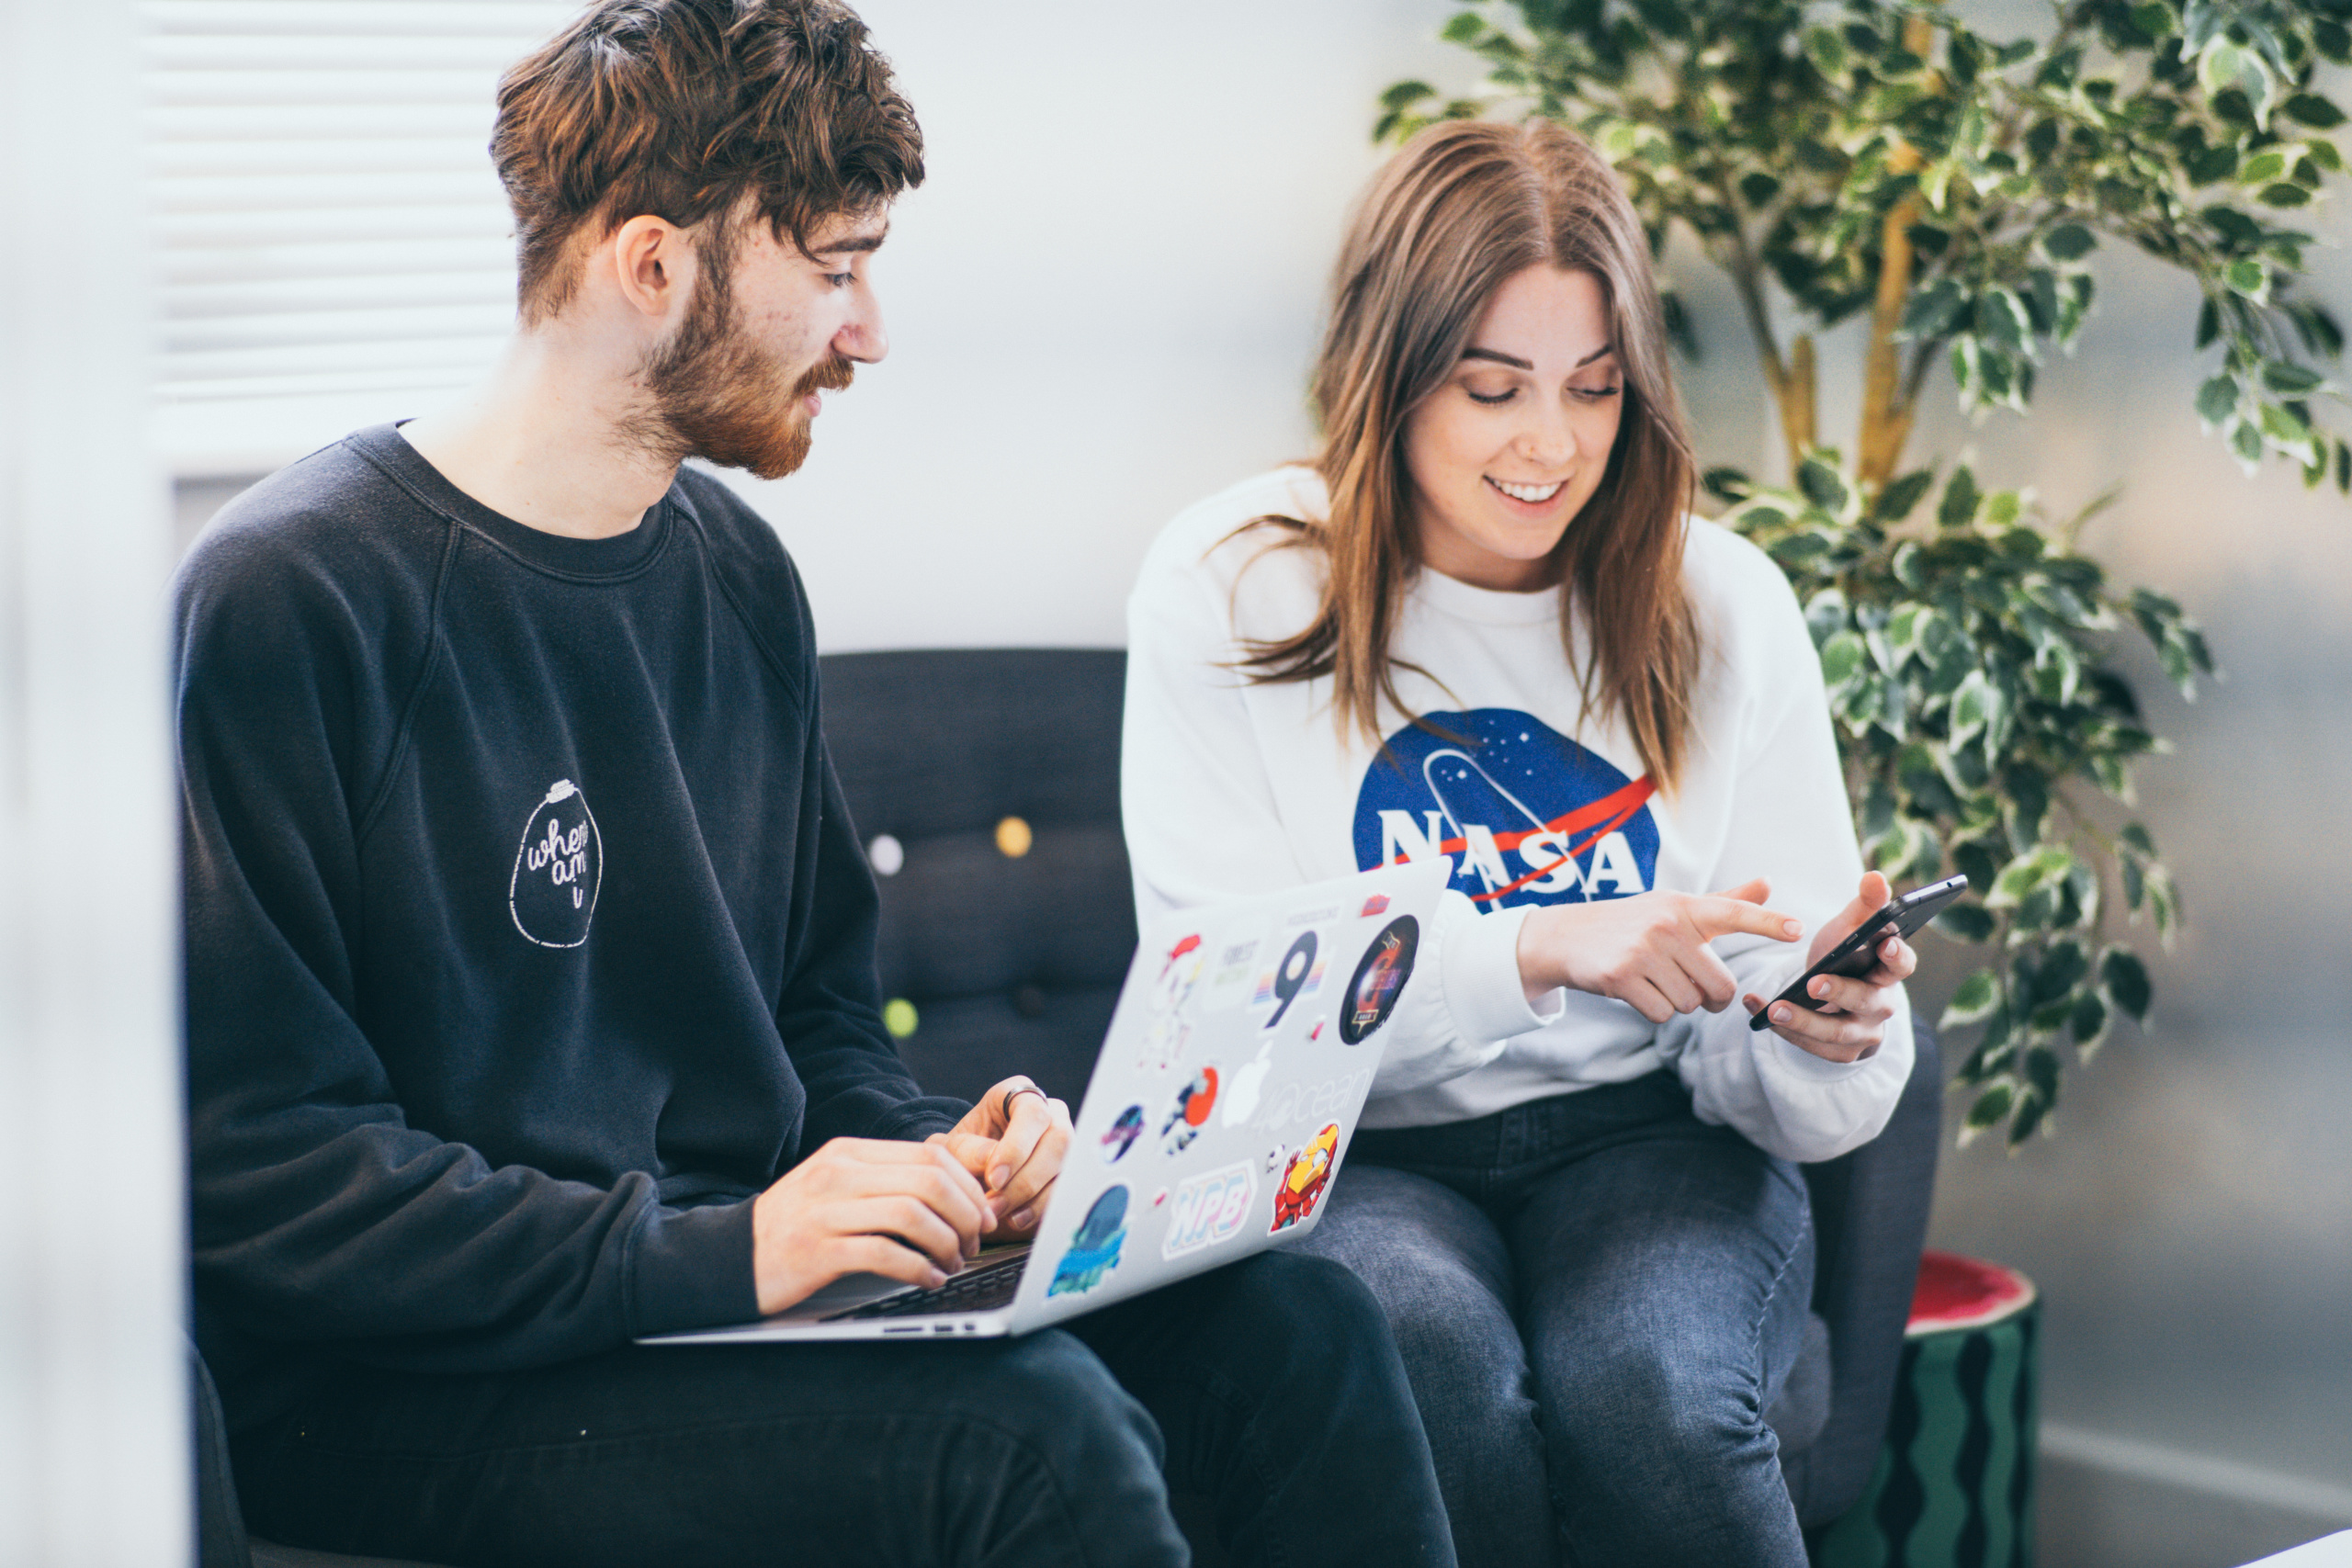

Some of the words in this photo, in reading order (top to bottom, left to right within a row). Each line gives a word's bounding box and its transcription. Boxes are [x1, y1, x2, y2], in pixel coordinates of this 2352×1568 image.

[552, 852, 586, 885] am
[1377, 809, 1645, 894] NASA
[1263, 930, 1318, 1029] 9
[1170, 1172, 1250, 1249] NPB
